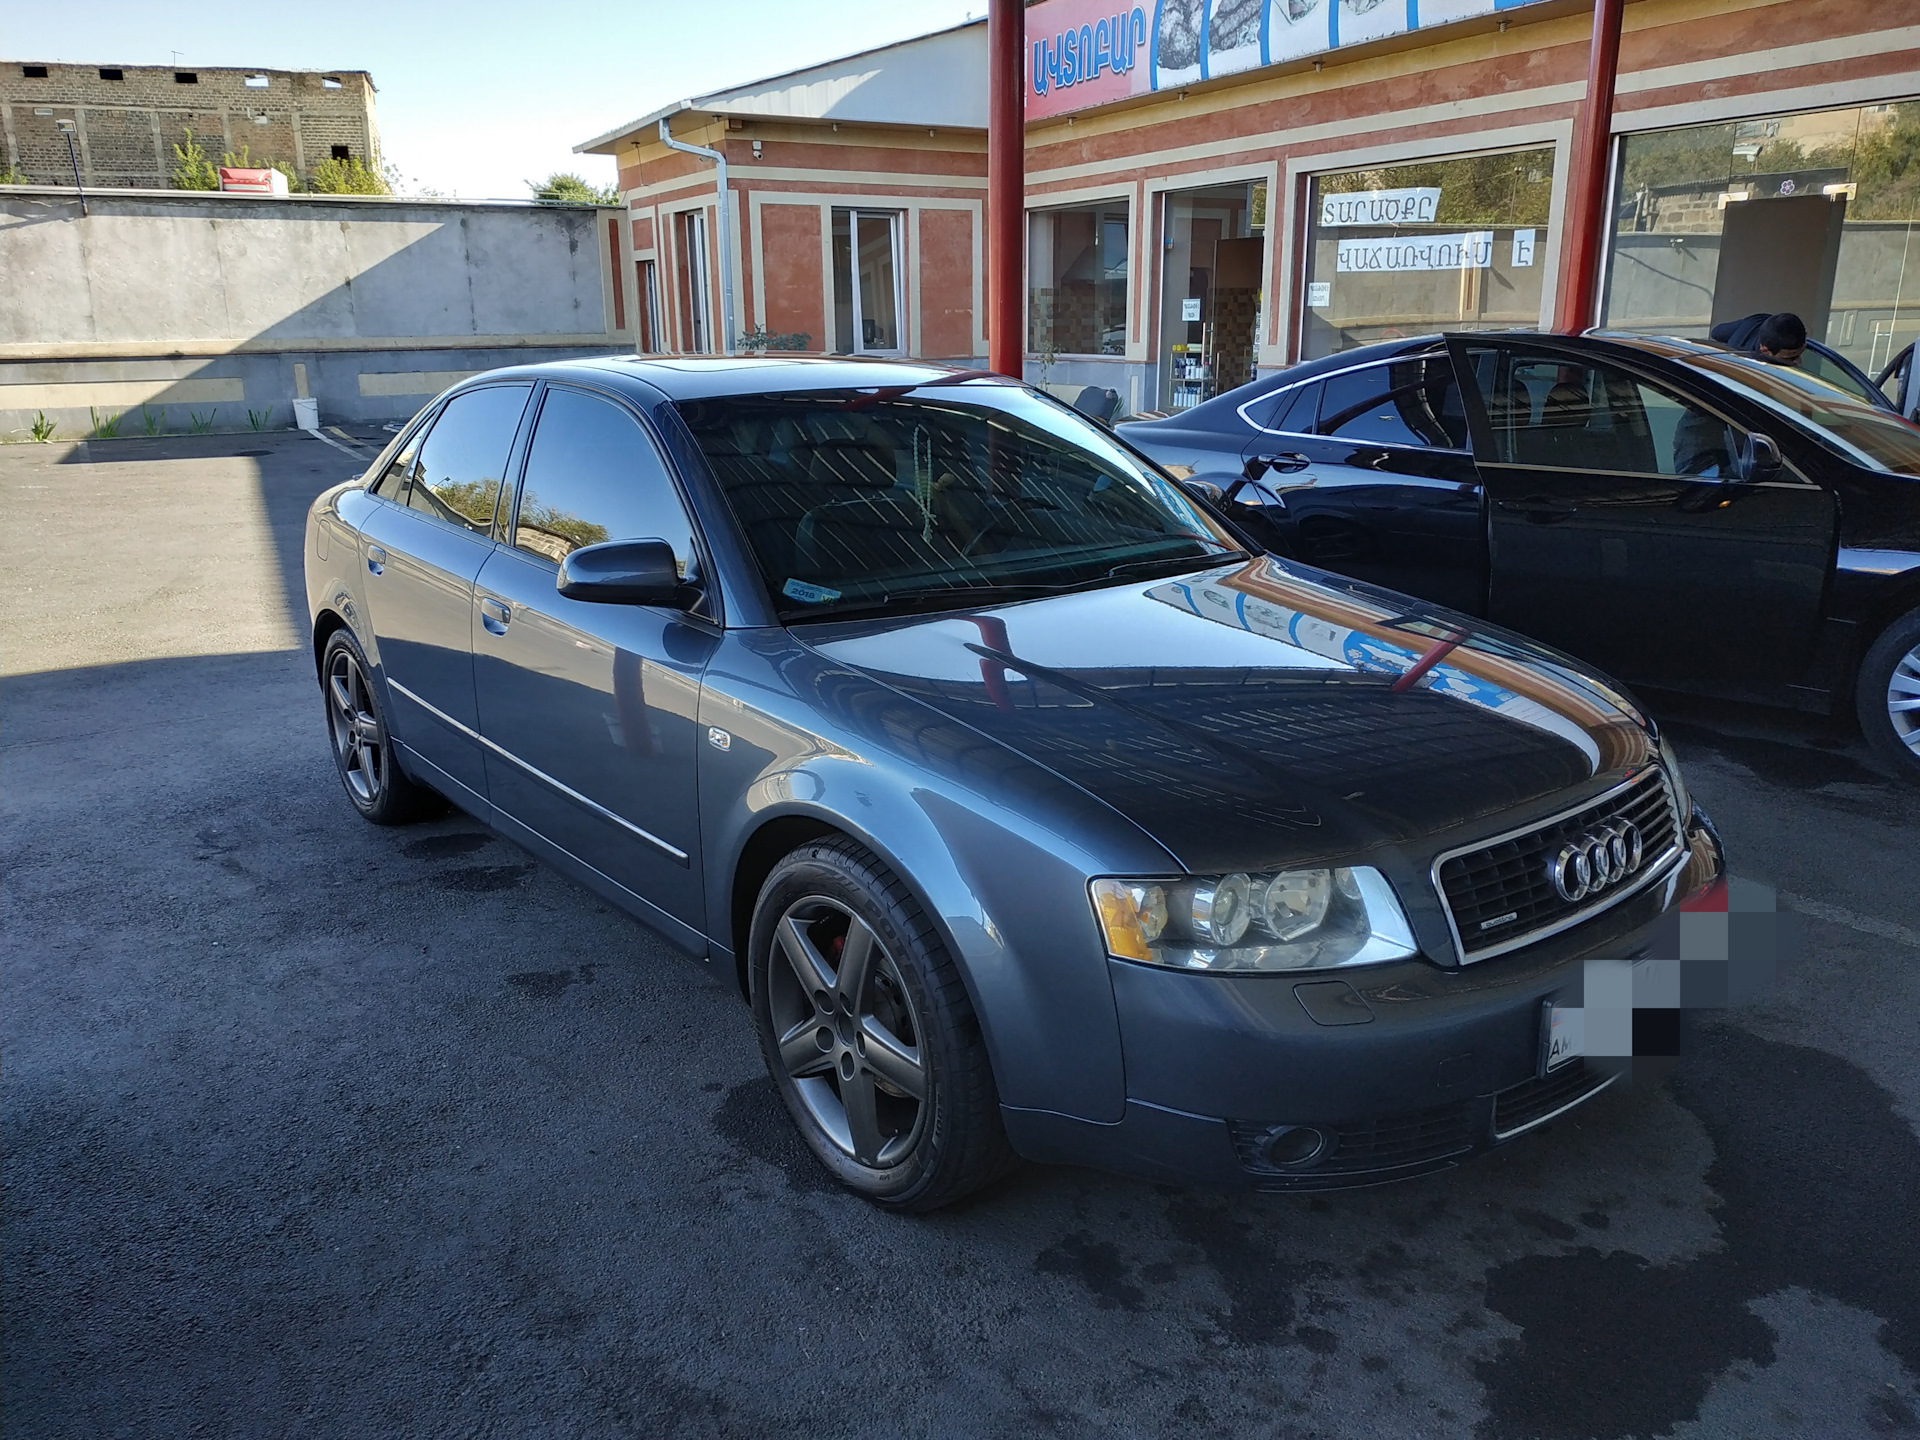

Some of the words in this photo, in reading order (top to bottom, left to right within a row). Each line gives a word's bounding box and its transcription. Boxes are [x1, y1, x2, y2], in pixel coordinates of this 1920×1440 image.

[1033, 6, 1146, 95] ԱՎՏՈԲԱՐ
[1324, 196, 1432, 223] ՏԱՐԱԾՔԸ
[1517, 240, 1530, 265] Է
[791, 588, 816, 599] 2018
